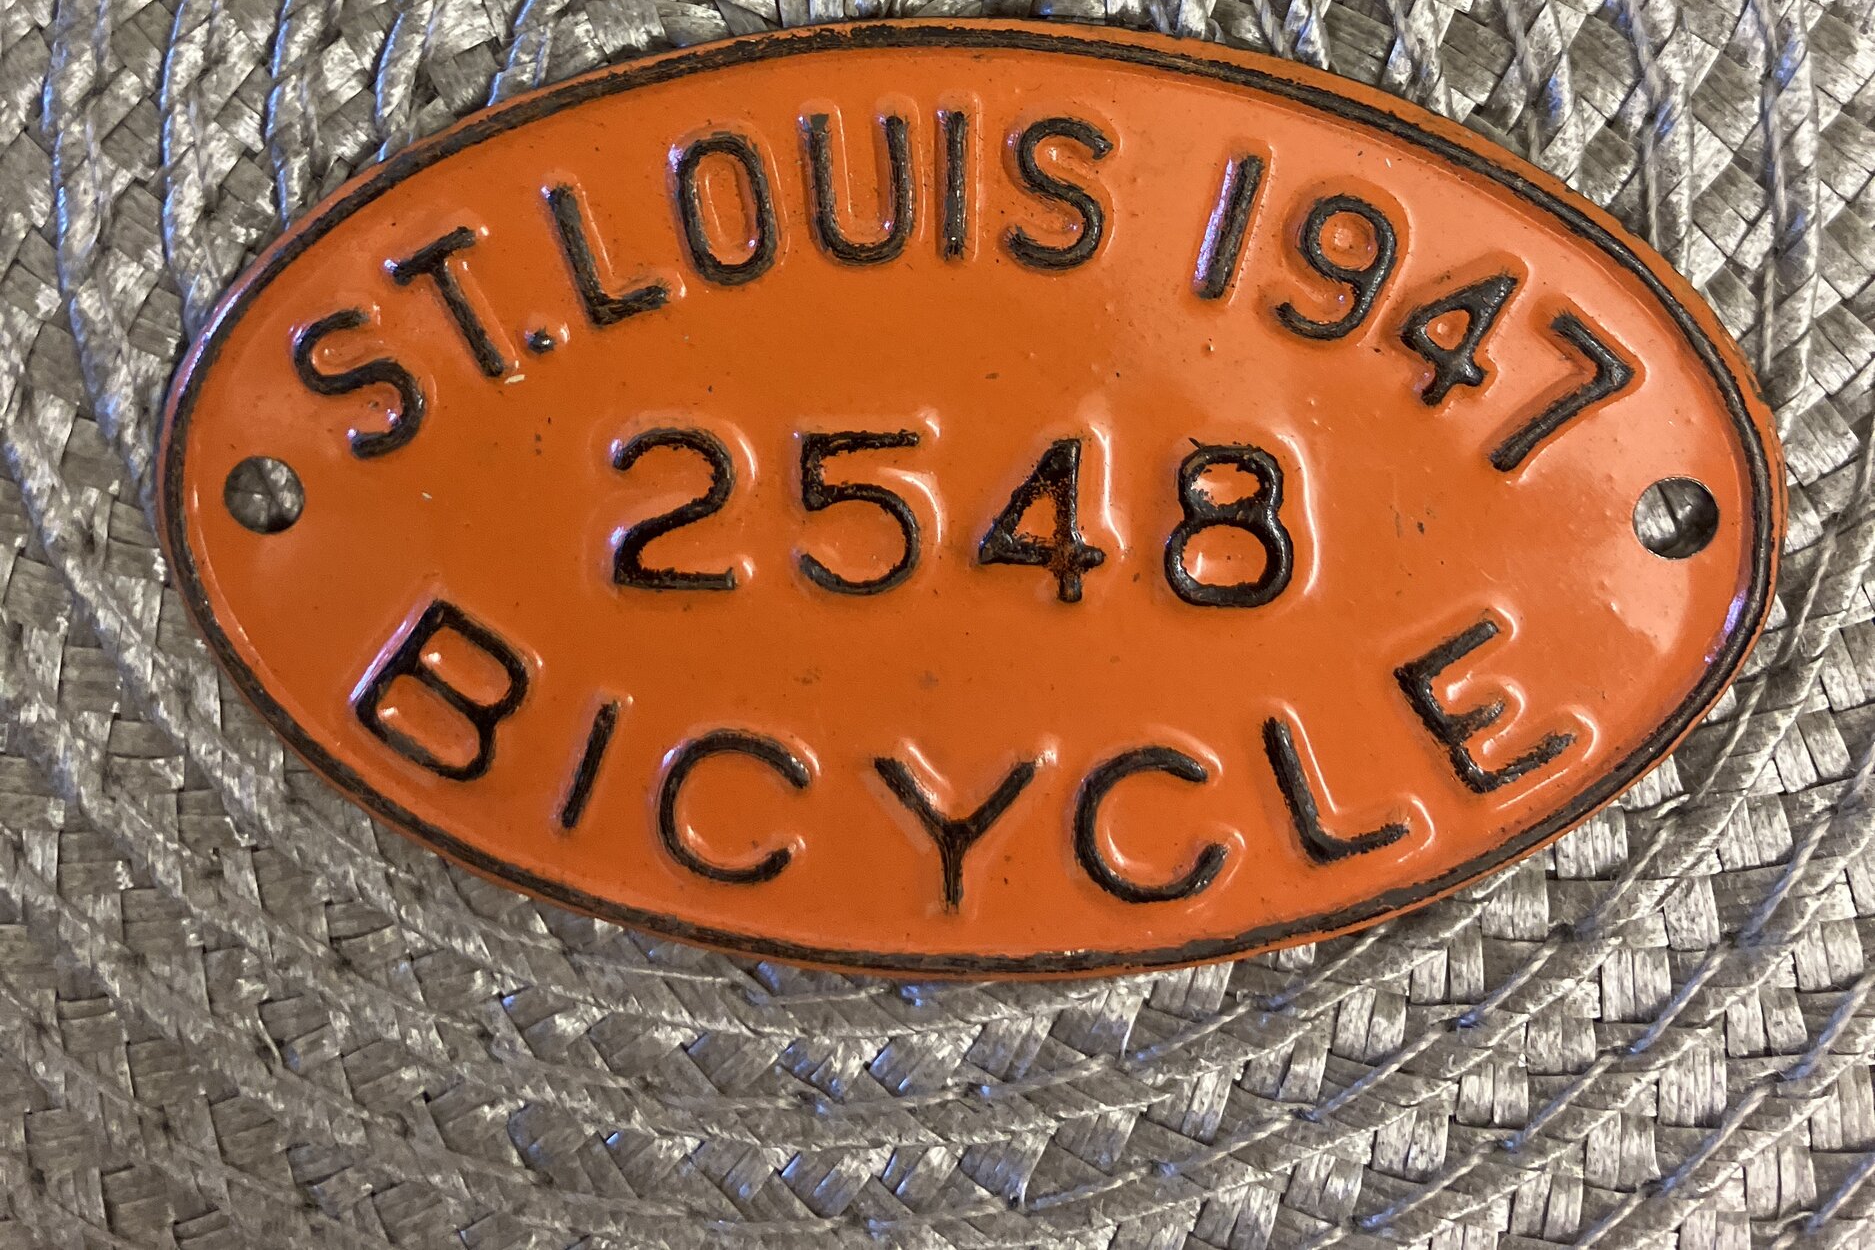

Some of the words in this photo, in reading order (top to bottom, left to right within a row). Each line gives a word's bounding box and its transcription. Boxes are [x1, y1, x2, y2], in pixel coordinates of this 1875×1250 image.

[1200, 152, 1634, 471] 1947
[616, 429, 1292, 607] 2548
[356, 600, 1573, 910] BICYCLE
